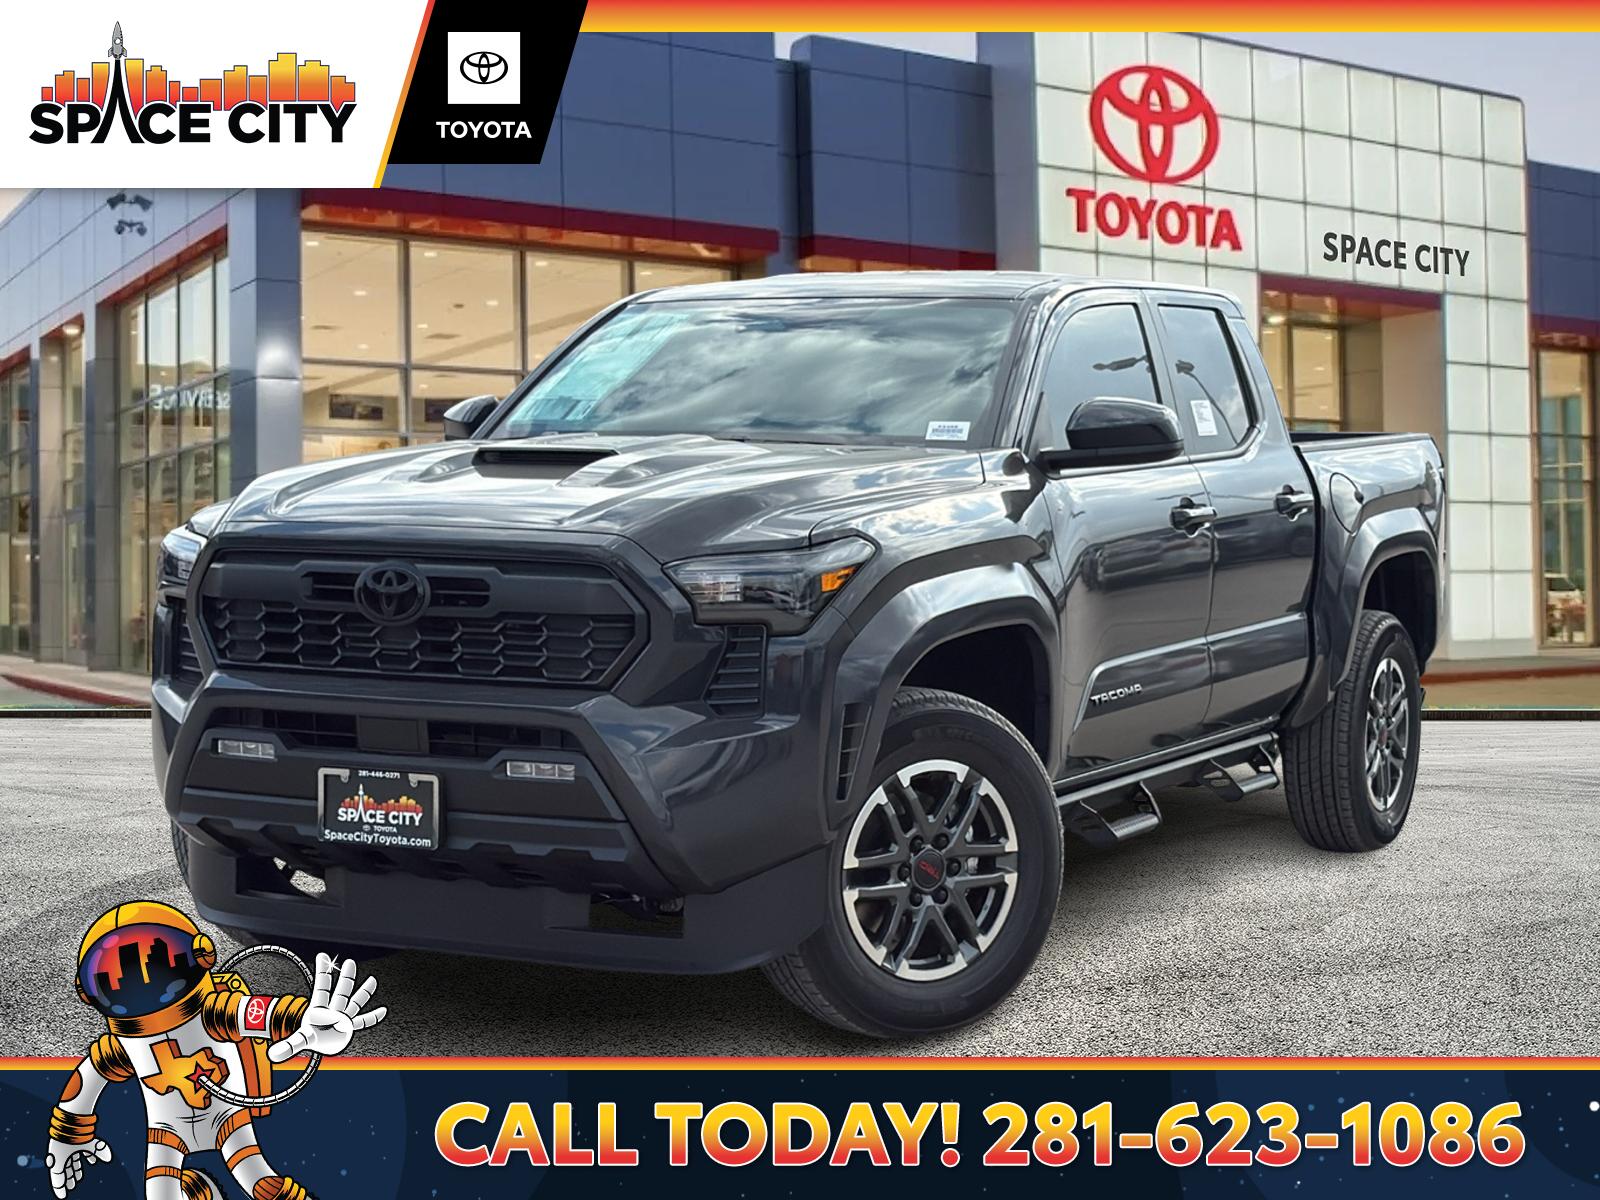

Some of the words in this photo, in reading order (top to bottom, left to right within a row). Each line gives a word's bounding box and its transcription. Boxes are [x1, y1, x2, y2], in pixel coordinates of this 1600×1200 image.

[1066, 188, 1242, 251] TOYOTA
[1323, 232, 1407, 270] SPACE
[1414, 244, 1470, 277] CITY
[1090, 683, 1143, 705] TACOMA
[388, 811, 423, 826] CITY
[324, 829, 431, 847] SpaceCityToyota.com
[373, 825, 398, 833] TOYOTA
